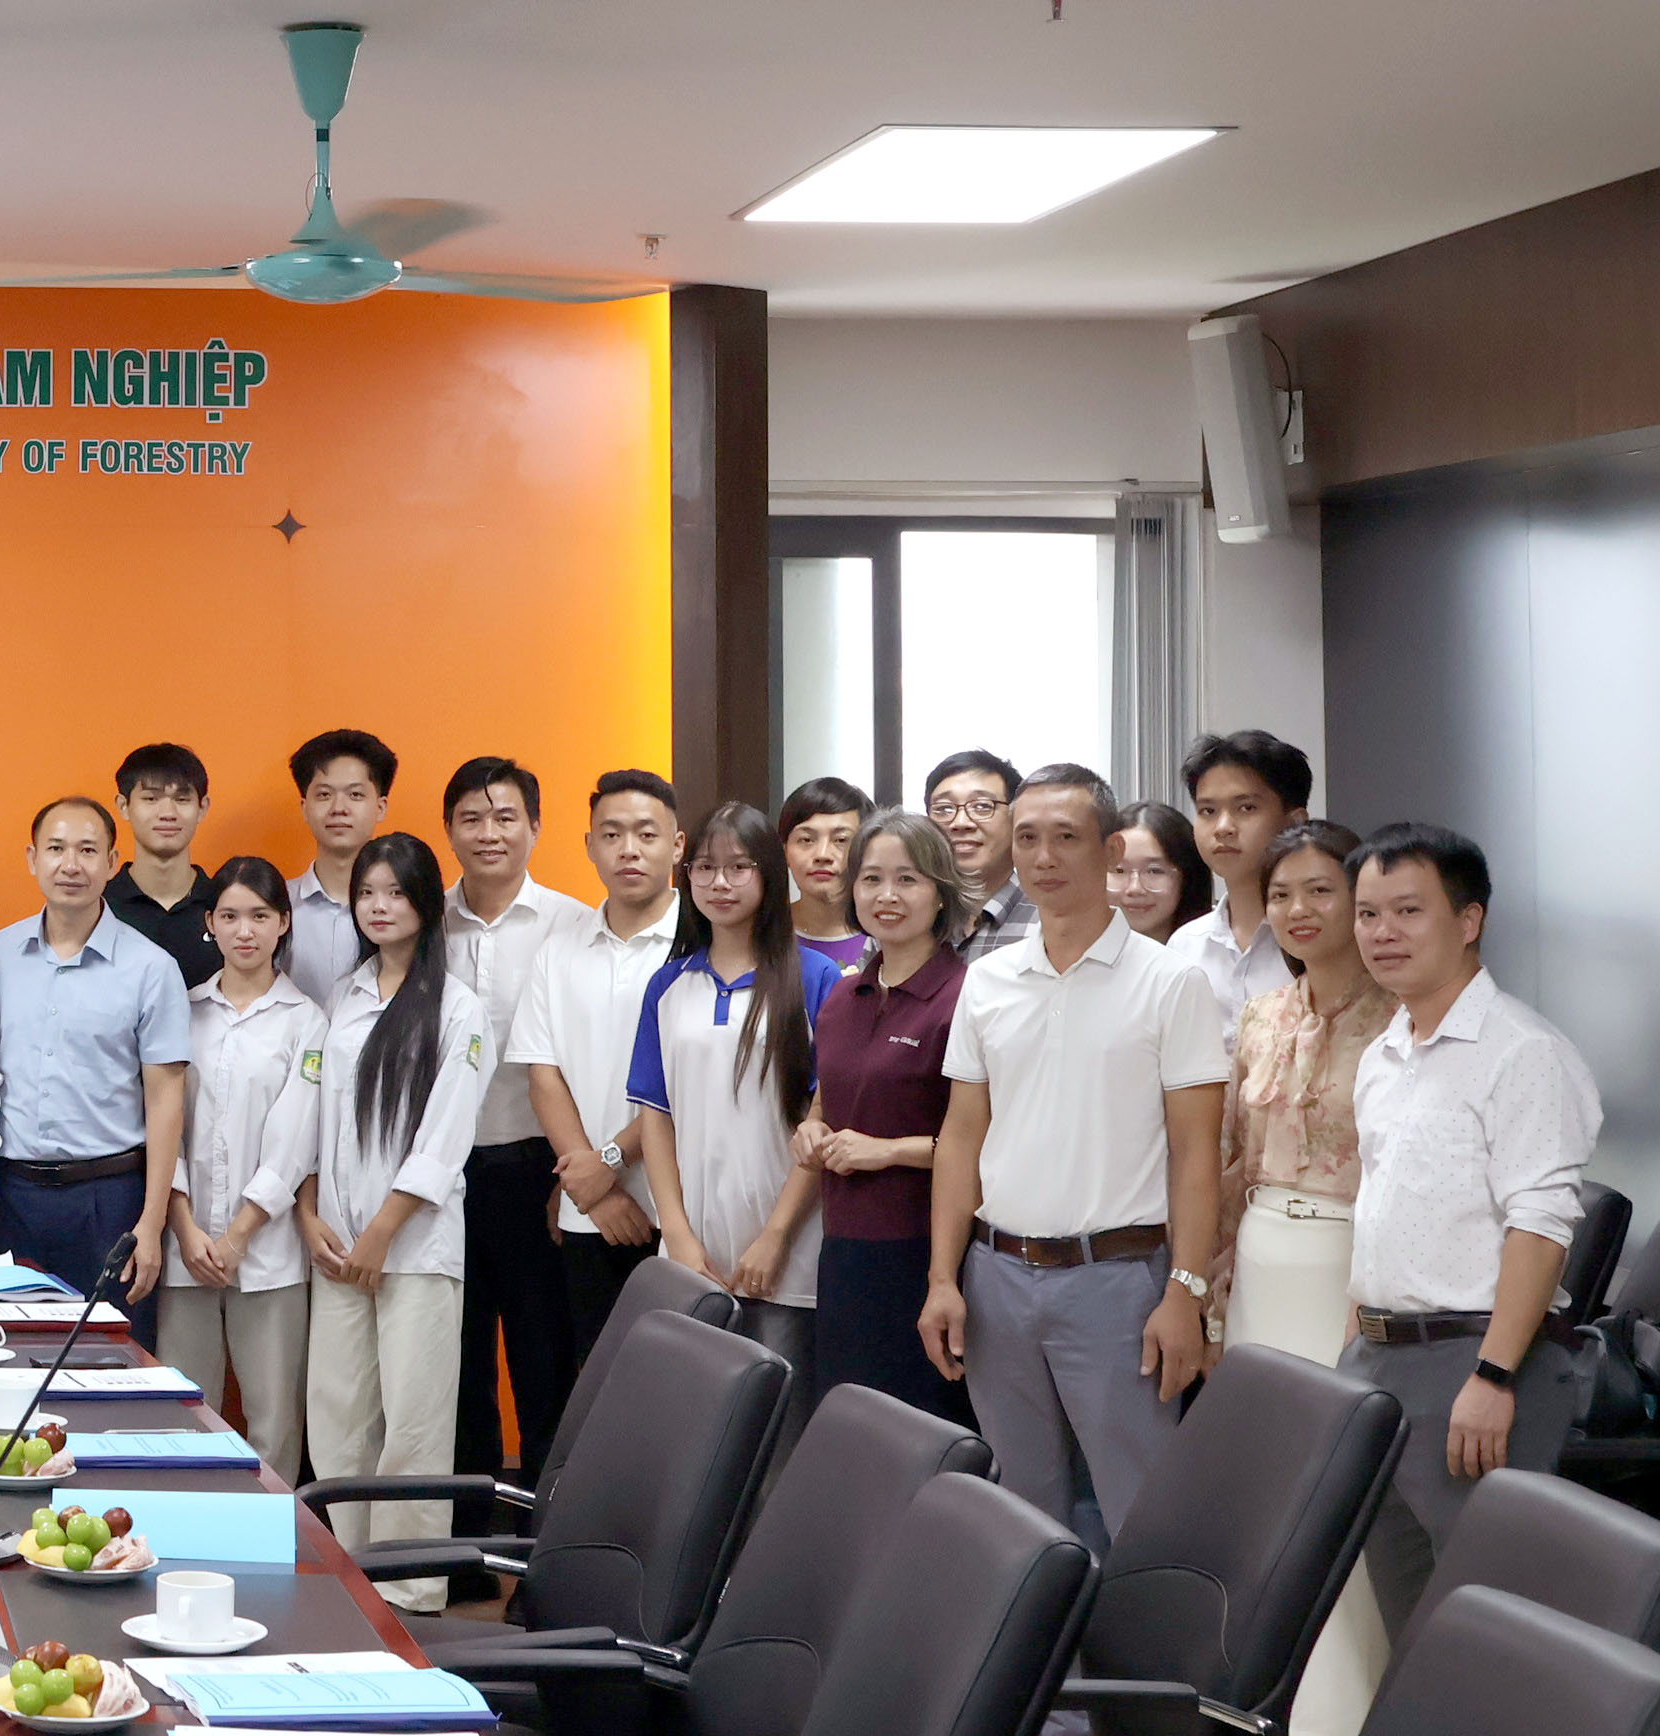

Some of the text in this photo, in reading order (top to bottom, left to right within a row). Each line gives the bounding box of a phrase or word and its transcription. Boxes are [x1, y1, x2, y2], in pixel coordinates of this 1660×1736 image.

[71, 338, 267, 424] NGHIỆP
[22, 439, 66, 474] OF
[79, 440, 252, 475] FORESTRY
